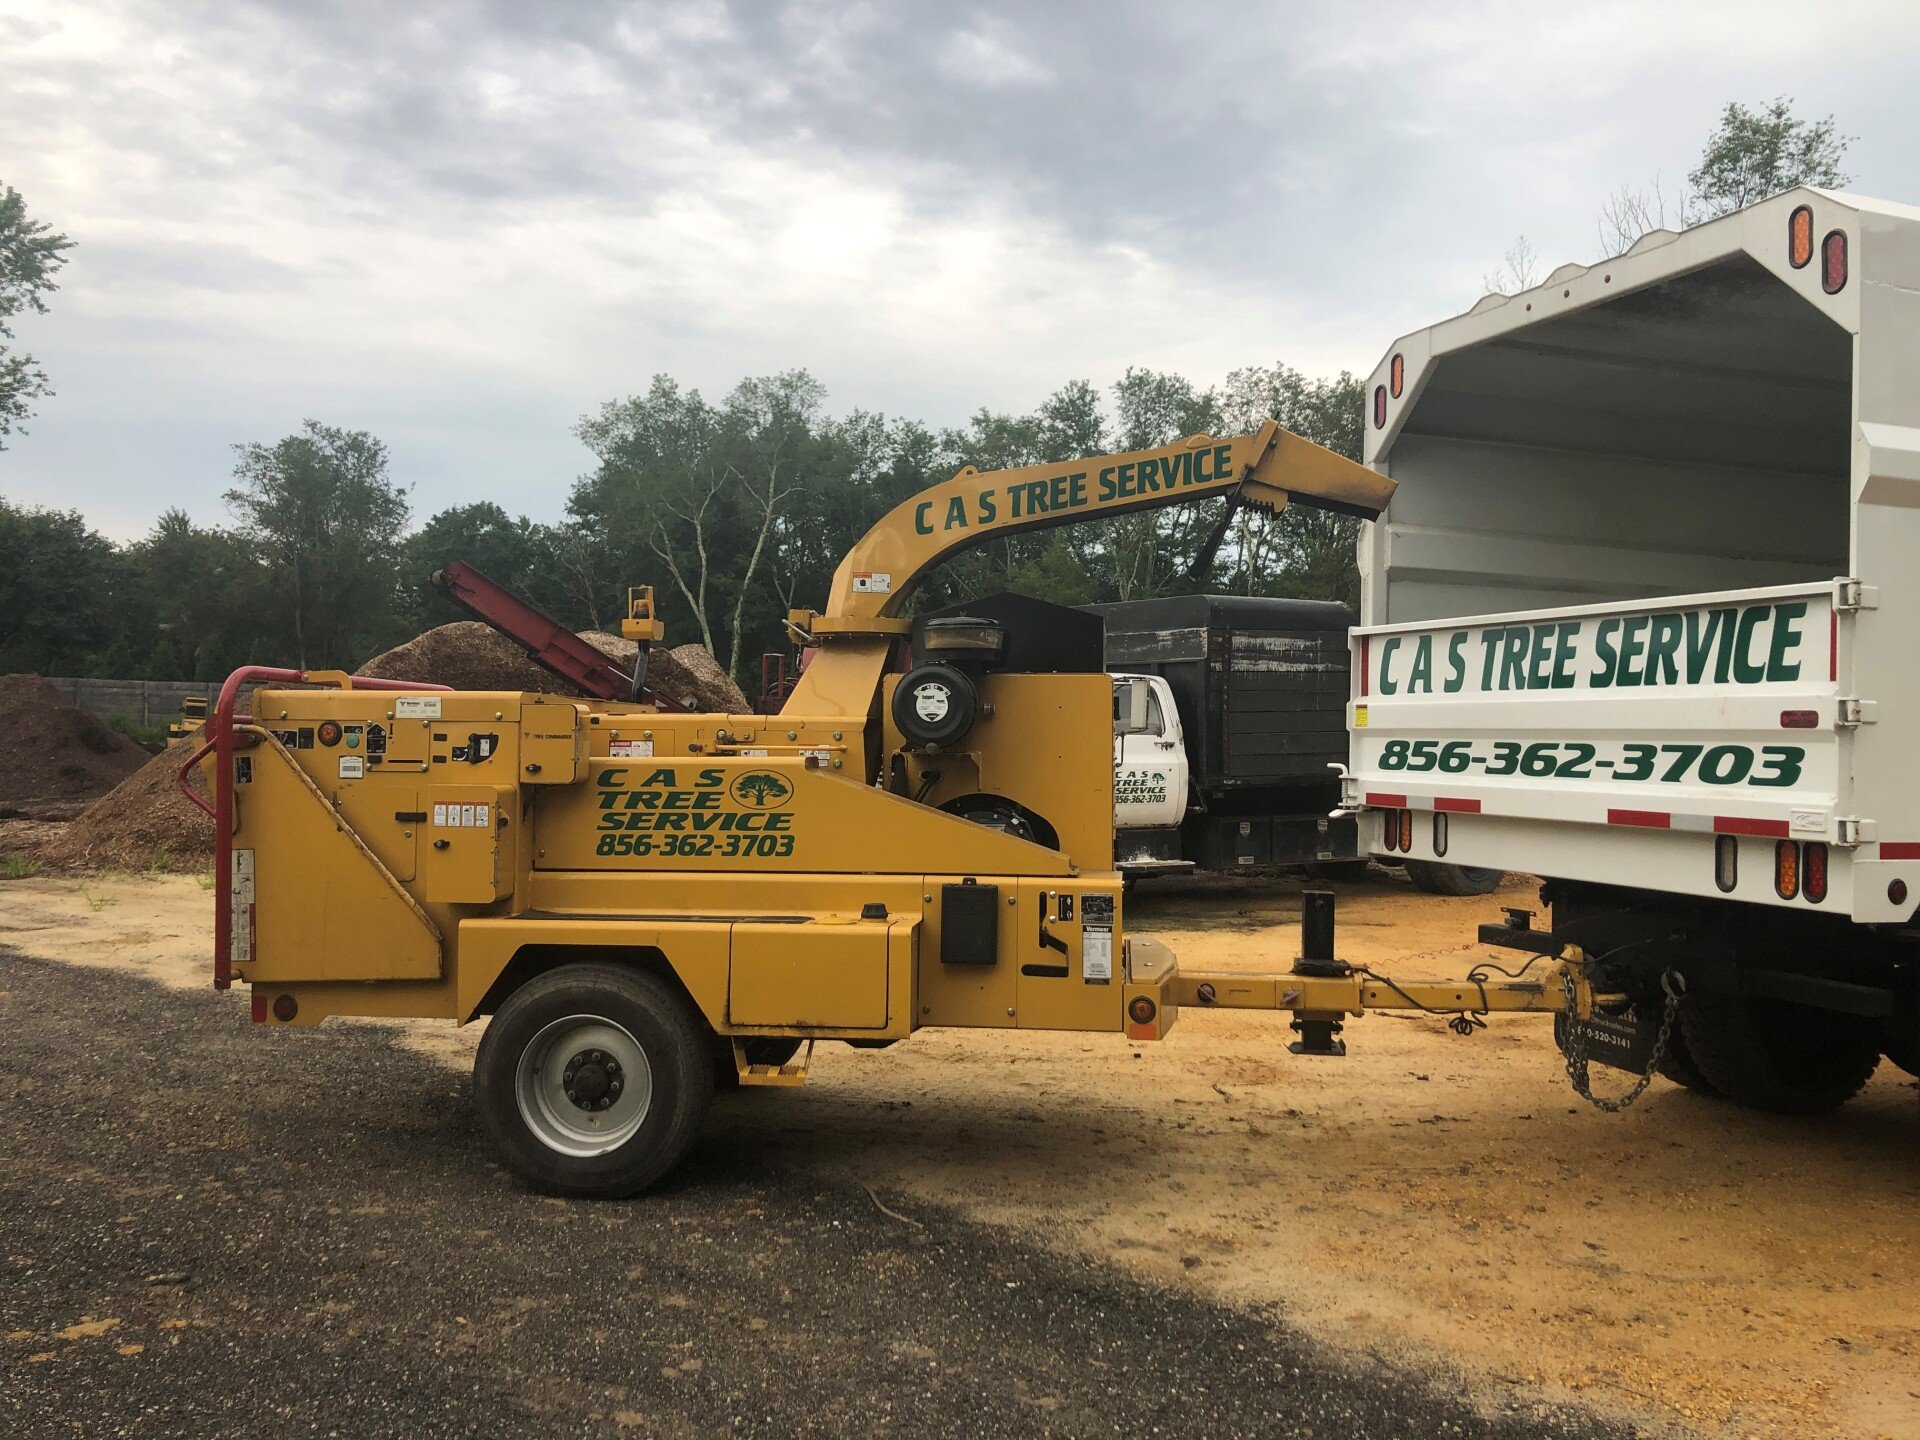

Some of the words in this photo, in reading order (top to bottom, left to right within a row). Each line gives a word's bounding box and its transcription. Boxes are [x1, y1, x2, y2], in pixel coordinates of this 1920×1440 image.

[1007, 472, 1088, 518] TREE
[1099, 444, 1233, 501] SERVICE
[1481, 621, 1582, 691] TREE
[1589, 602, 1808, 689] SERVICE
[1377, 740, 1805, 787] 856-362-3703
[597, 791, 724, 810] TREE
[596, 813, 795, 831] SERVICE
[596, 834, 795, 857] 856-362-3703
[1577, 1025, 1630, 1049] 80-520-3141
